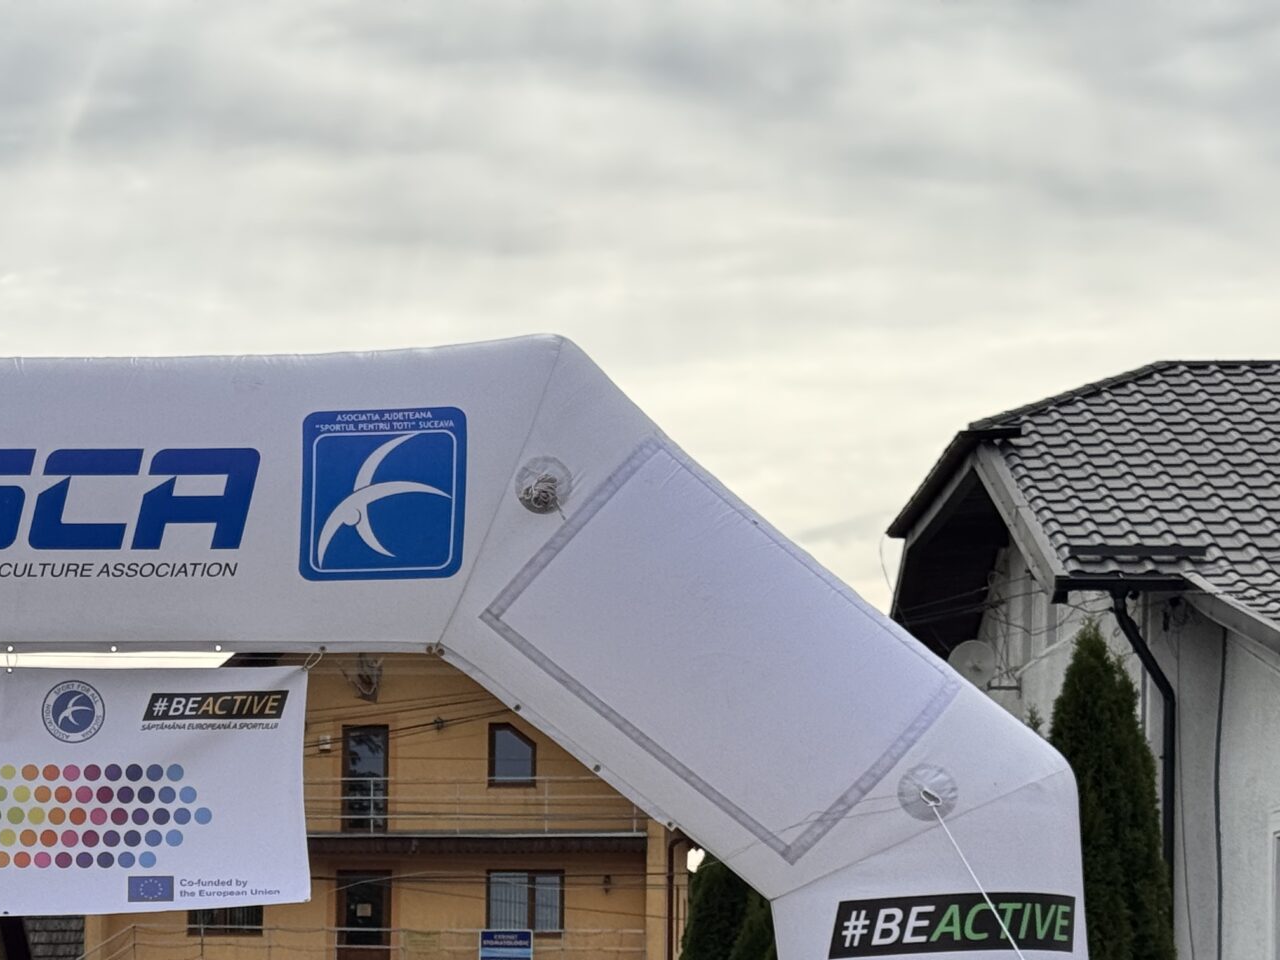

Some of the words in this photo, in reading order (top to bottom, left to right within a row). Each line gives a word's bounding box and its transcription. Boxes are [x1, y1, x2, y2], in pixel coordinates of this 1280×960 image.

[418, 419, 455, 429] SUCEAVA
[97, 561, 239, 578] ASSOCIATION
[152, 694, 281, 717] #BEACTIVE
[180, 878, 232, 888] Co-funded
[235, 878, 248, 890] by
[180, 889, 196, 898] the
[198, 888, 248, 899] European
[250, 888, 280, 897] Union
[842, 903, 1071, 948] #BEACTIVE
